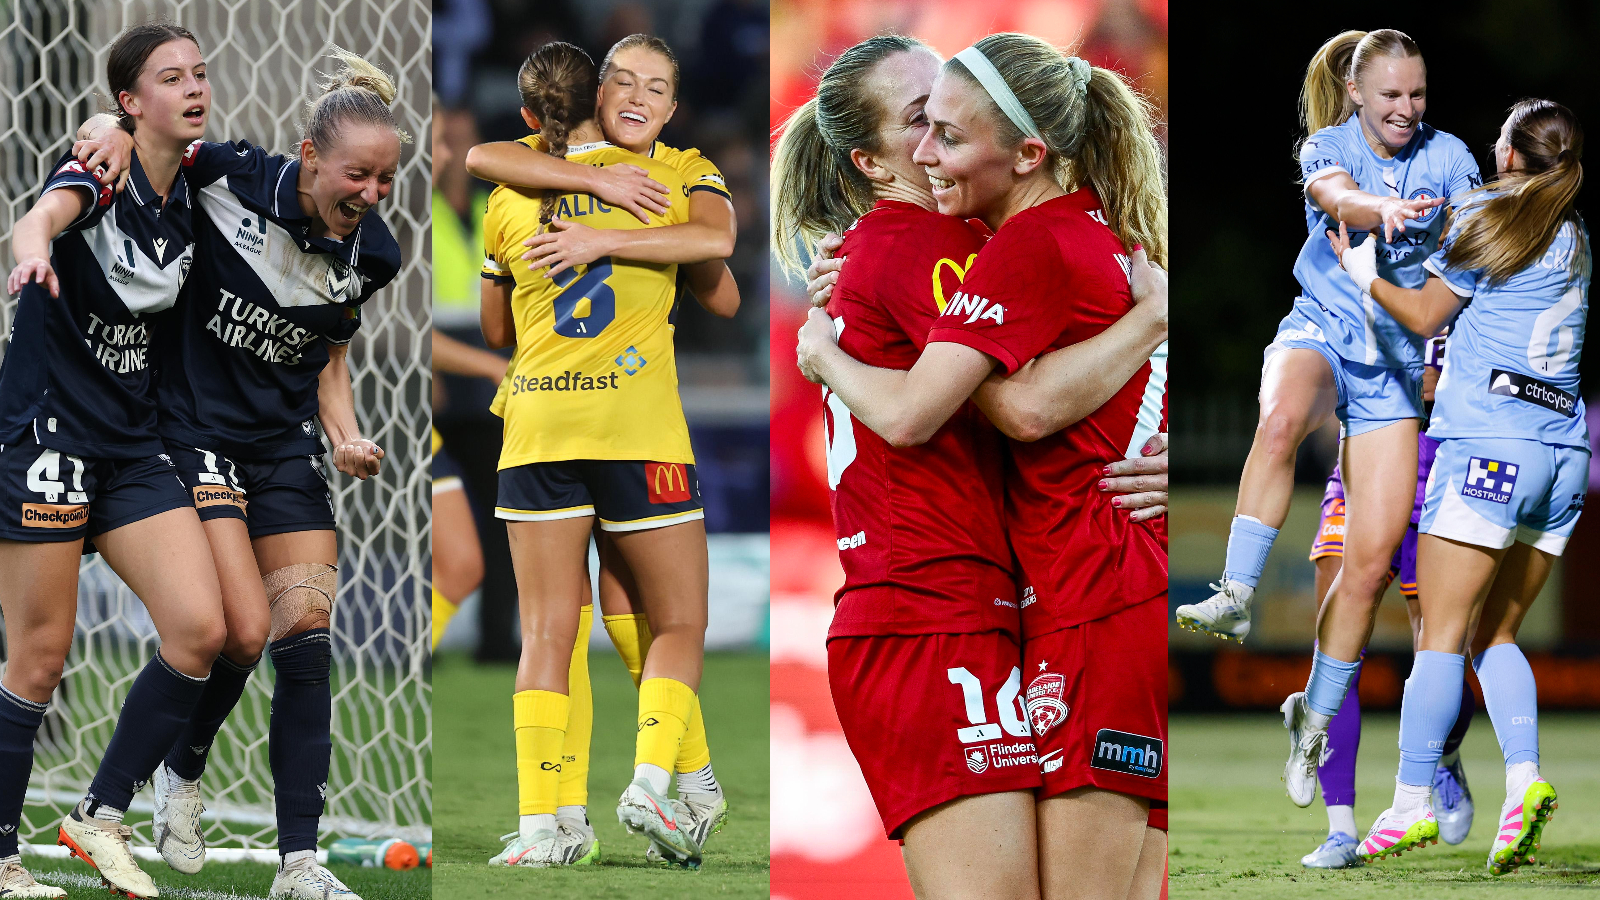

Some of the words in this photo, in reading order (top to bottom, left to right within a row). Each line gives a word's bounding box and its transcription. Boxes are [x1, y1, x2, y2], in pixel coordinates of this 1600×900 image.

[236, 227, 264, 247] NINJA
[111, 262, 135, 279] NINJA
[218, 287, 319, 350] TURKISH
[940, 291, 1005, 326] INJA
[205, 313, 303, 366] AIRLINES
[1526, 286, 1584, 377] 6
[512, 370, 619, 396] Steadfast
[26, 448, 90, 503] 41
[1463, 486, 1510, 503] HOSTPLUS
[24, 508, 84, 525] Checkpoint
[837, 530, 867, 551] een
[1322, 523, 1345, 536] Coa
[947, 665, 1032, 744] 16
[1512, 716, 1535, 725] CITY
[989, 742, 1036, 756] Flinders
[1098, 742, 1158, 768] mmh
